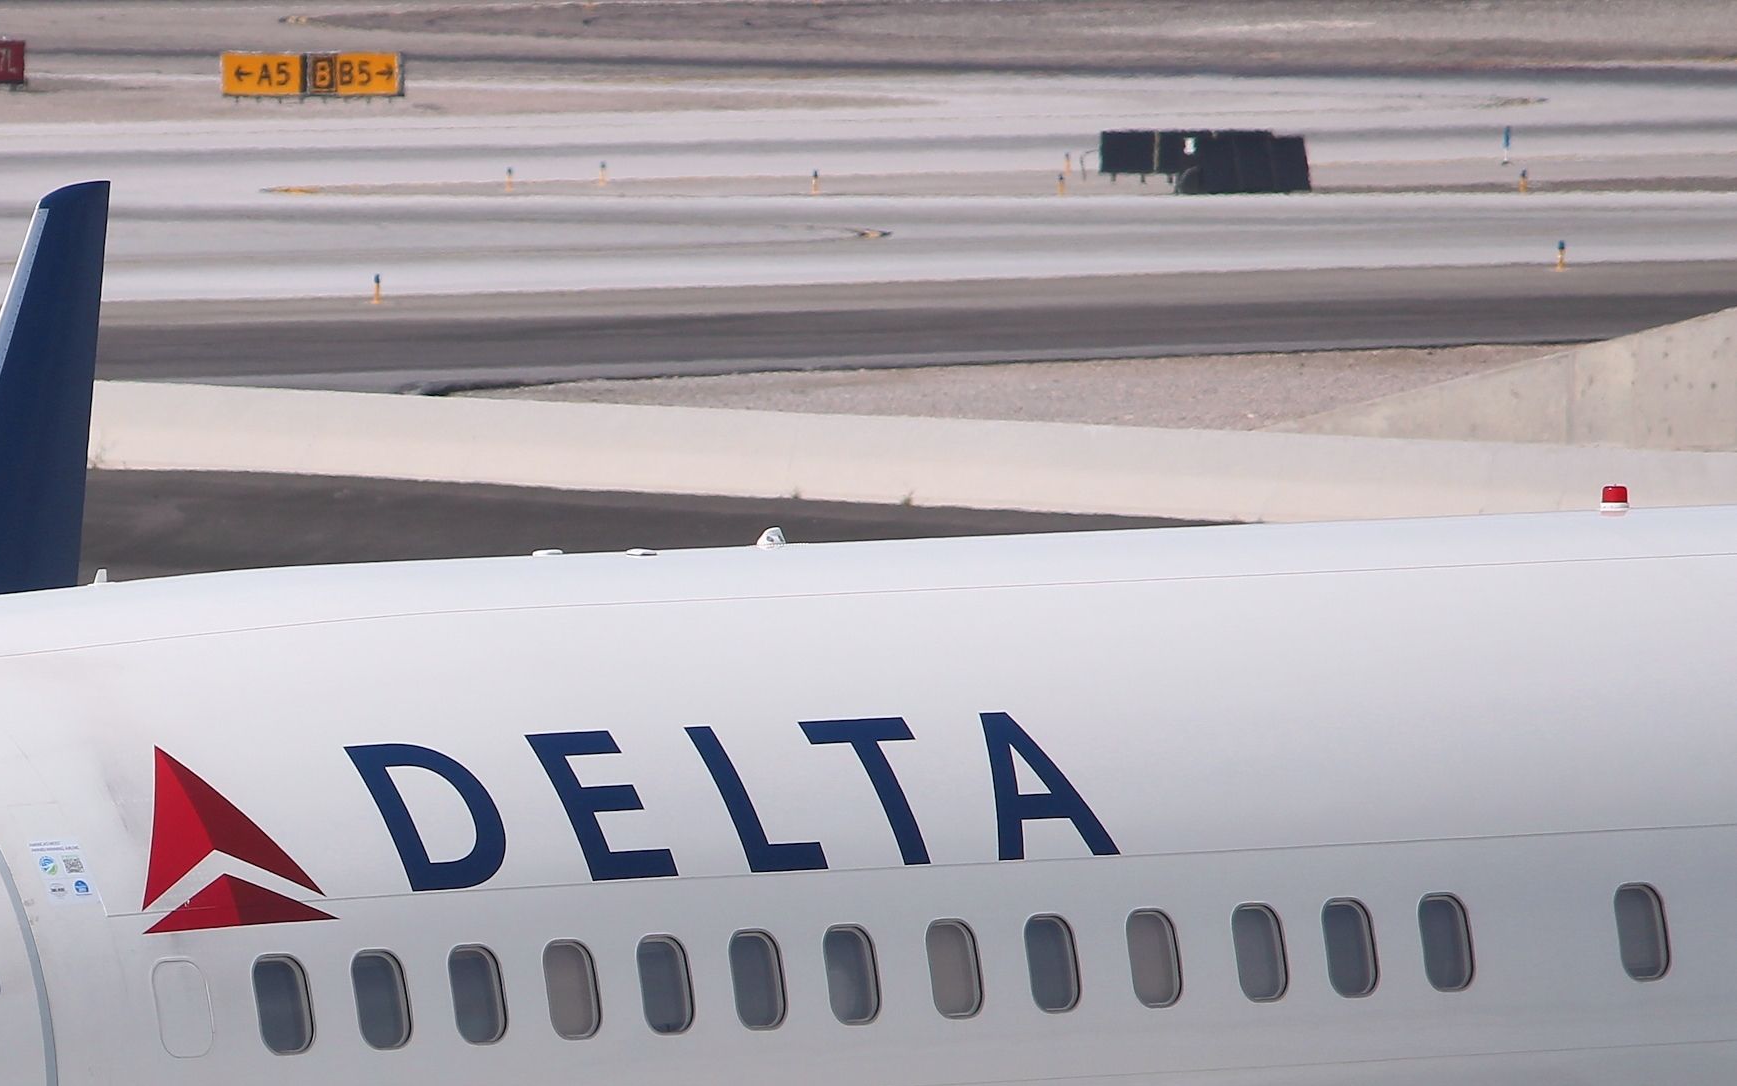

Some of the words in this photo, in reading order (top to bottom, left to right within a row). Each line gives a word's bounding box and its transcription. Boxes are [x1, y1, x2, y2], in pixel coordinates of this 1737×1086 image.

[257, 62, 291, 87] A5
[315, 61, 331, 89] B
[339, 60, 372, 87] B5
[344, 712, 1121, 893] DELTA
